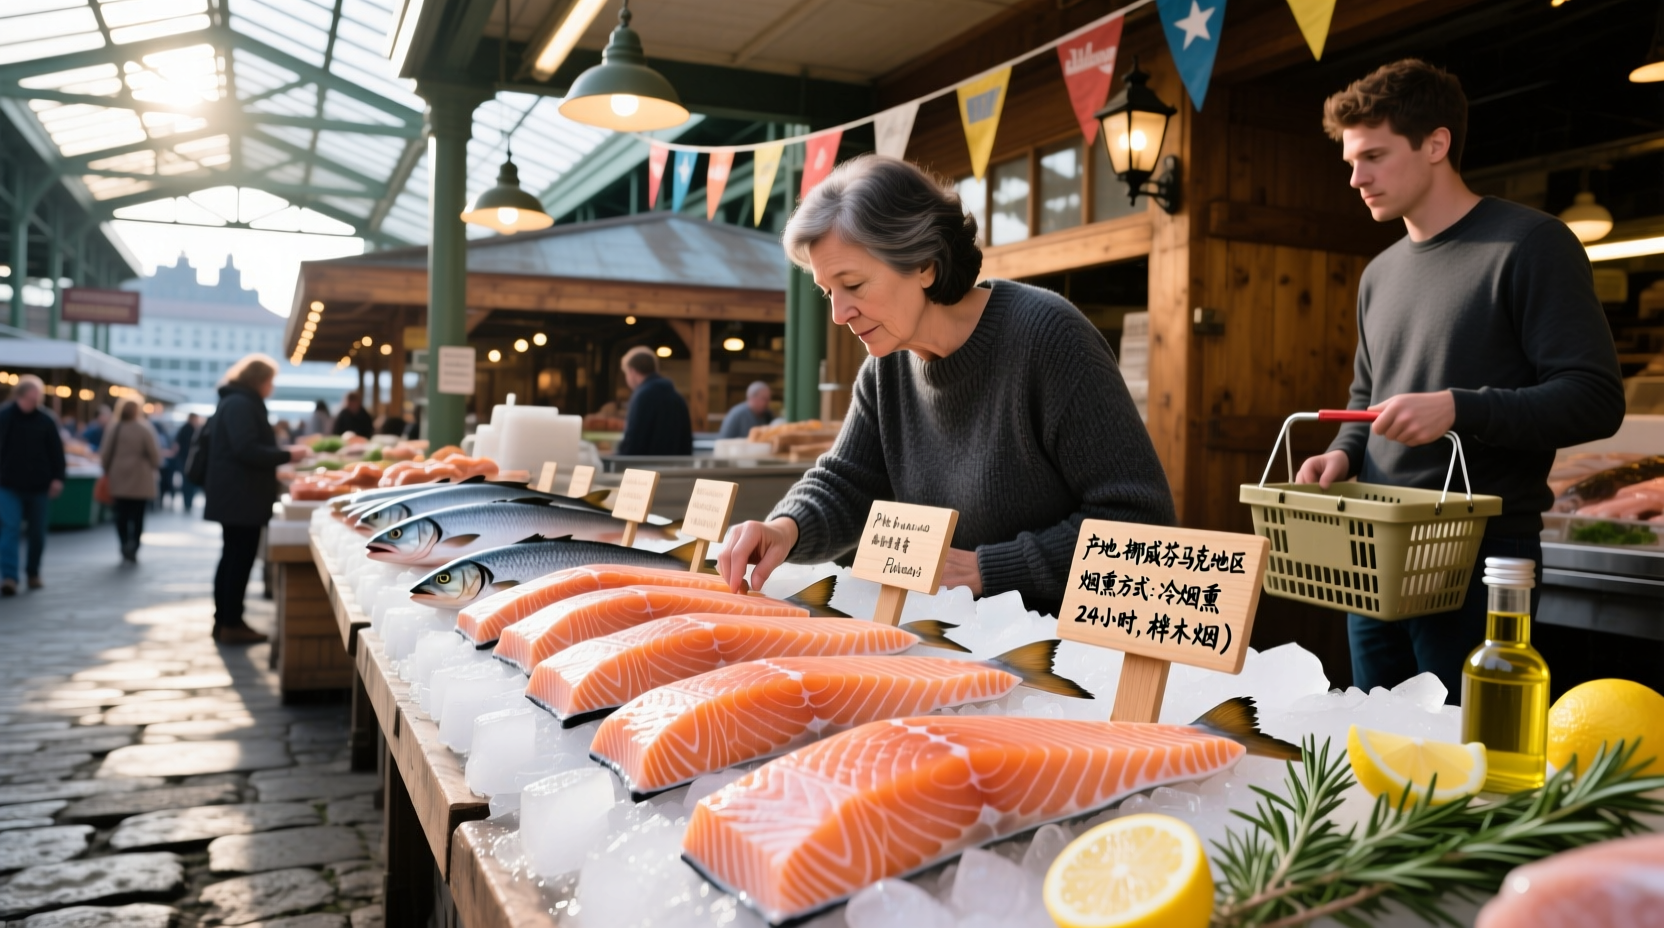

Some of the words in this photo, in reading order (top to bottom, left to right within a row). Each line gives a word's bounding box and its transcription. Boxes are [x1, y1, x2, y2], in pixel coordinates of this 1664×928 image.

[1079, 570, 1221, 613] 烟熏方式：冷烟熏
